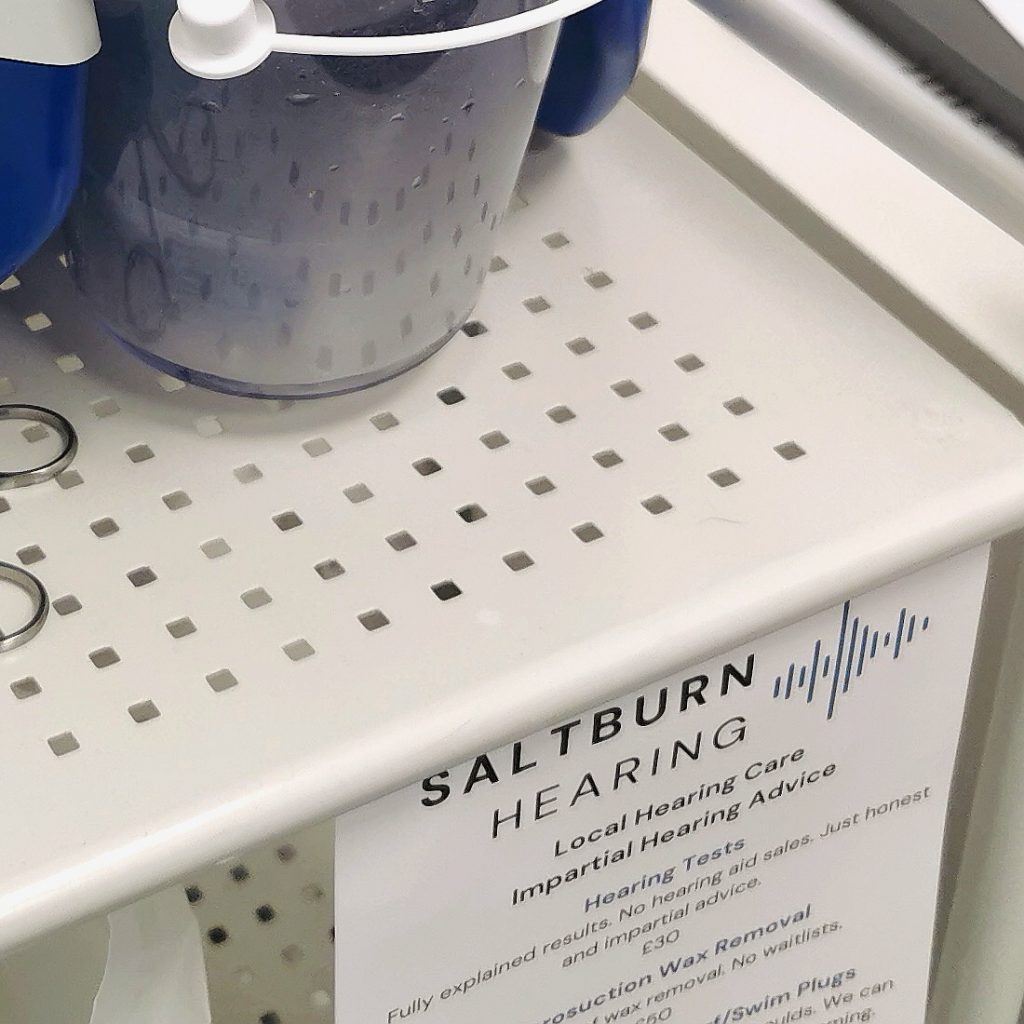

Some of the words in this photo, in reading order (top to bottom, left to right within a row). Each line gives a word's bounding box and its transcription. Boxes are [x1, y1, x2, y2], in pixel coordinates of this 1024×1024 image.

[421, 653, 755, 807] SALTBURN
[492, 715, 748, 838] HEARING
[512, 841, 633, 906] Impartial
[640, 801, 741, 852] Hearing
[748, 762, 837, 809] Advice
[554, 812, 628, 857] Local
[635, 775, 735, 826] Hearing
[744, 747, 805, 780] Care
[387, 995, 434, 1024] Fully
[440, 946, 536, 1000] explained
[542, 918, 612, 955] results.
[619, 904, 645, 922] No
[652, 870, 723, 909] hearing
[729, 852, 757, 877] aid
[763, 834, 815, 862] sales.
[820, 812, 860, 838] Just
[865, 785, 932, 821] honest
[562, 940, 598, 968] and
[604, 902, 689, 950] impartial
[695, 877, 762, 913] advice.
[584, 867, 675, 913] Hearing
[682, 837, 746, 873] Tests
[540, 973, 652, 1024] rosuction
[658, 949, 708, 978] Wax
[715, 903, 811, 956] Removal
[604, 1001, 642, 1024] wax
[646, 963, 725, 1007] removal.
[731, 952, 756, 971] No
[763, 920, 843, 957] waitlists.
[642, 929, 680, 956] £30
[797, 967, 857, 997] Plugs
[824, 992, 854, 1010] We
[859, 978, 894, 999] can
